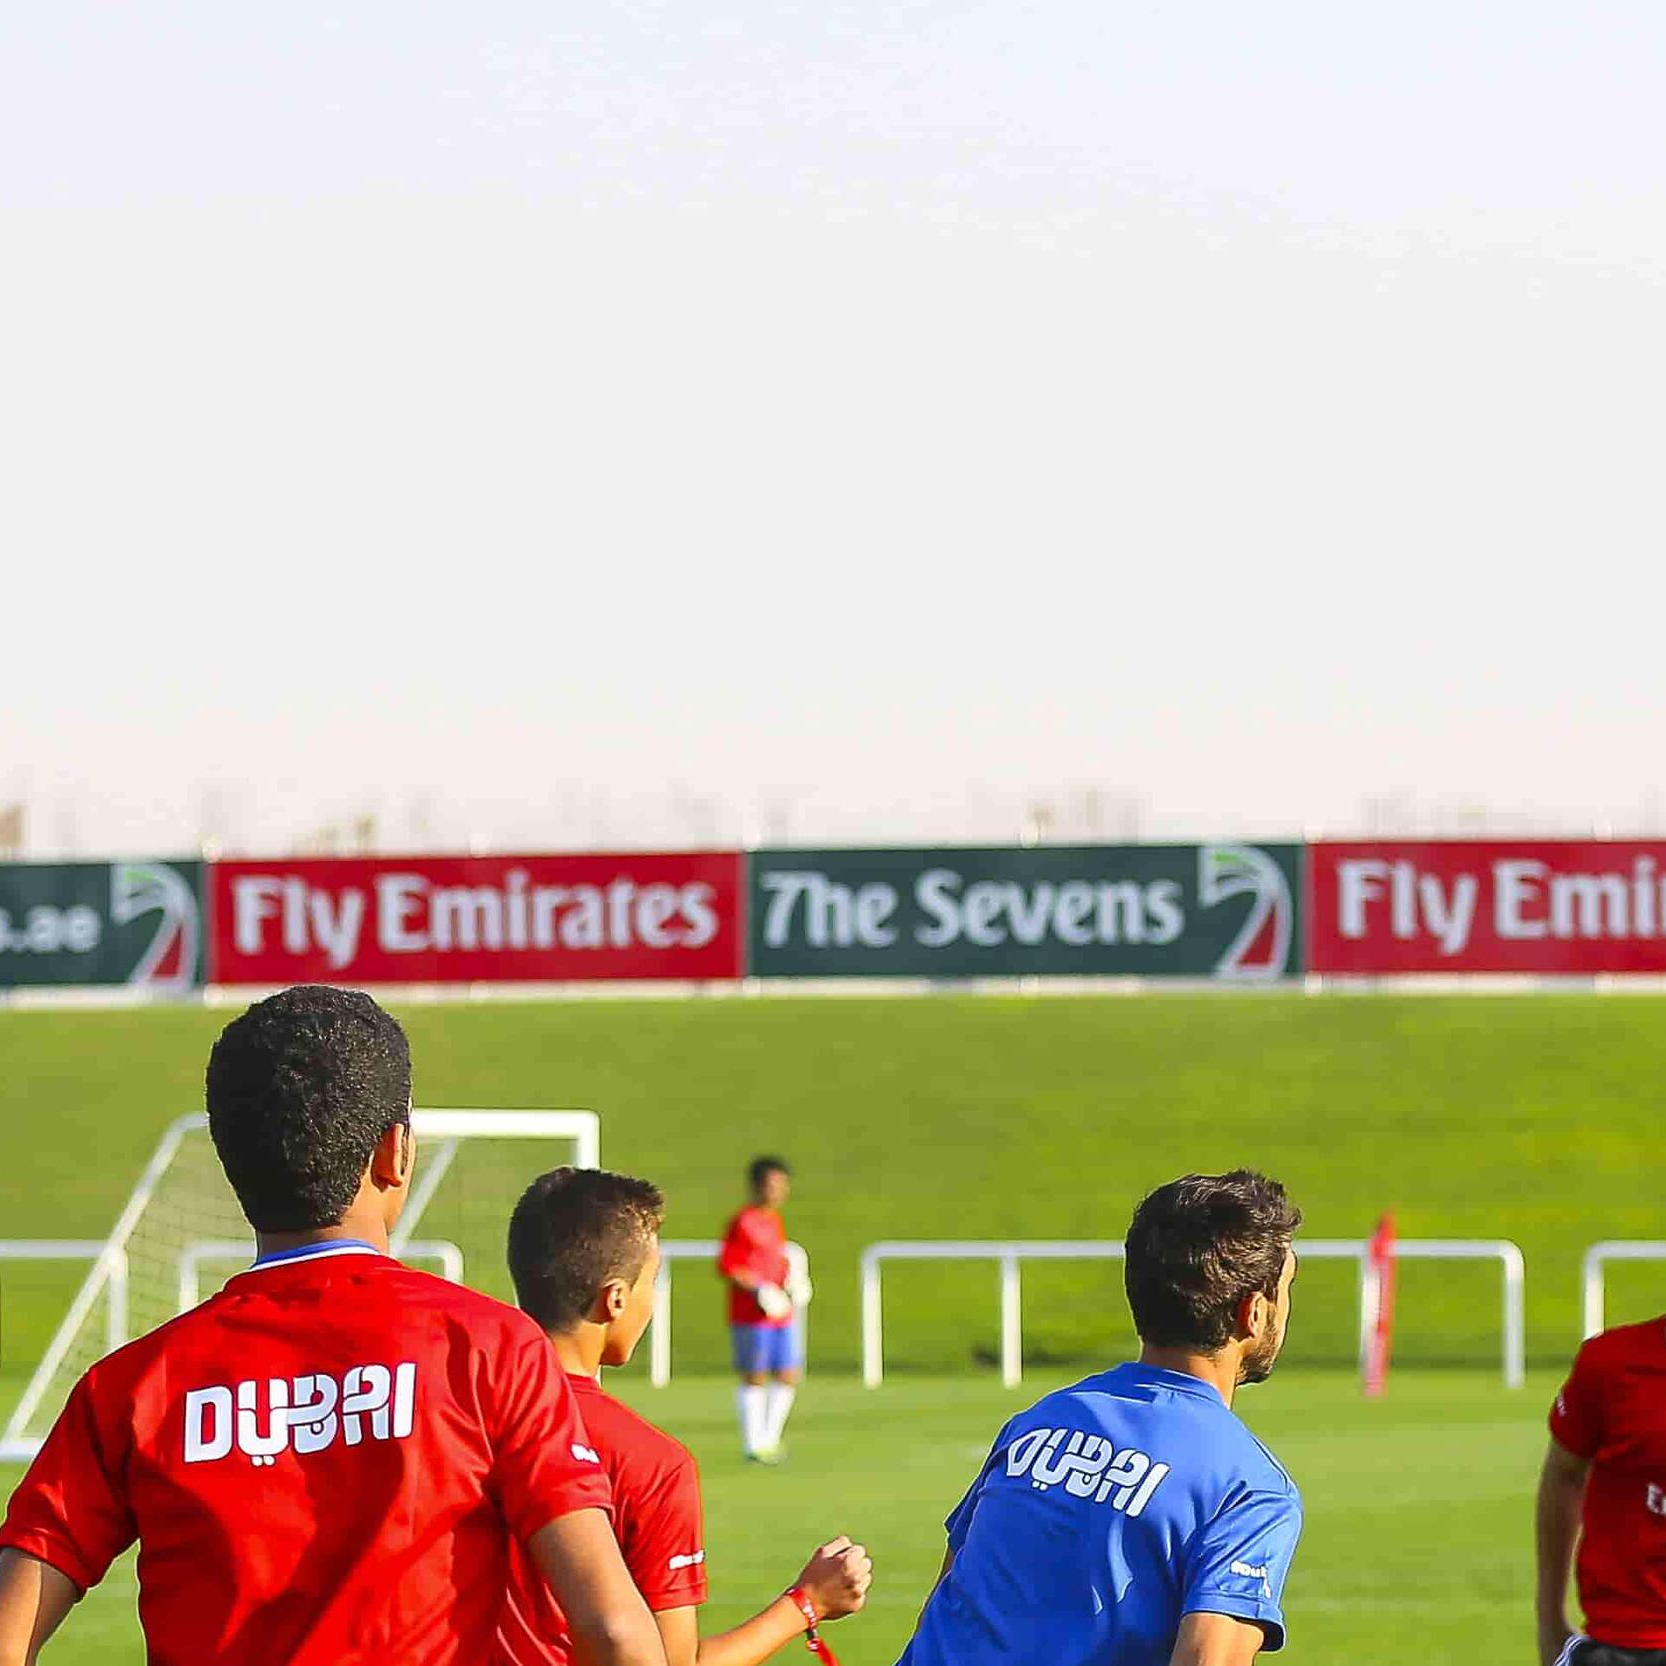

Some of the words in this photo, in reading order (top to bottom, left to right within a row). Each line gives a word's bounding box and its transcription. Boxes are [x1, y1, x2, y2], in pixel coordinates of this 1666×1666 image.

[231, 872, 365, 970] Fly
[375, 868, 720, 954] Emirates
[759, 869, 899, 948] The
[913, 868, 1185, 947] Sevens
[1336, 857, 1478, 956] Fly
[183, 1362, 417, 1466] DUBAI
[1006, 1427, 1171, 1519] DUBAI
